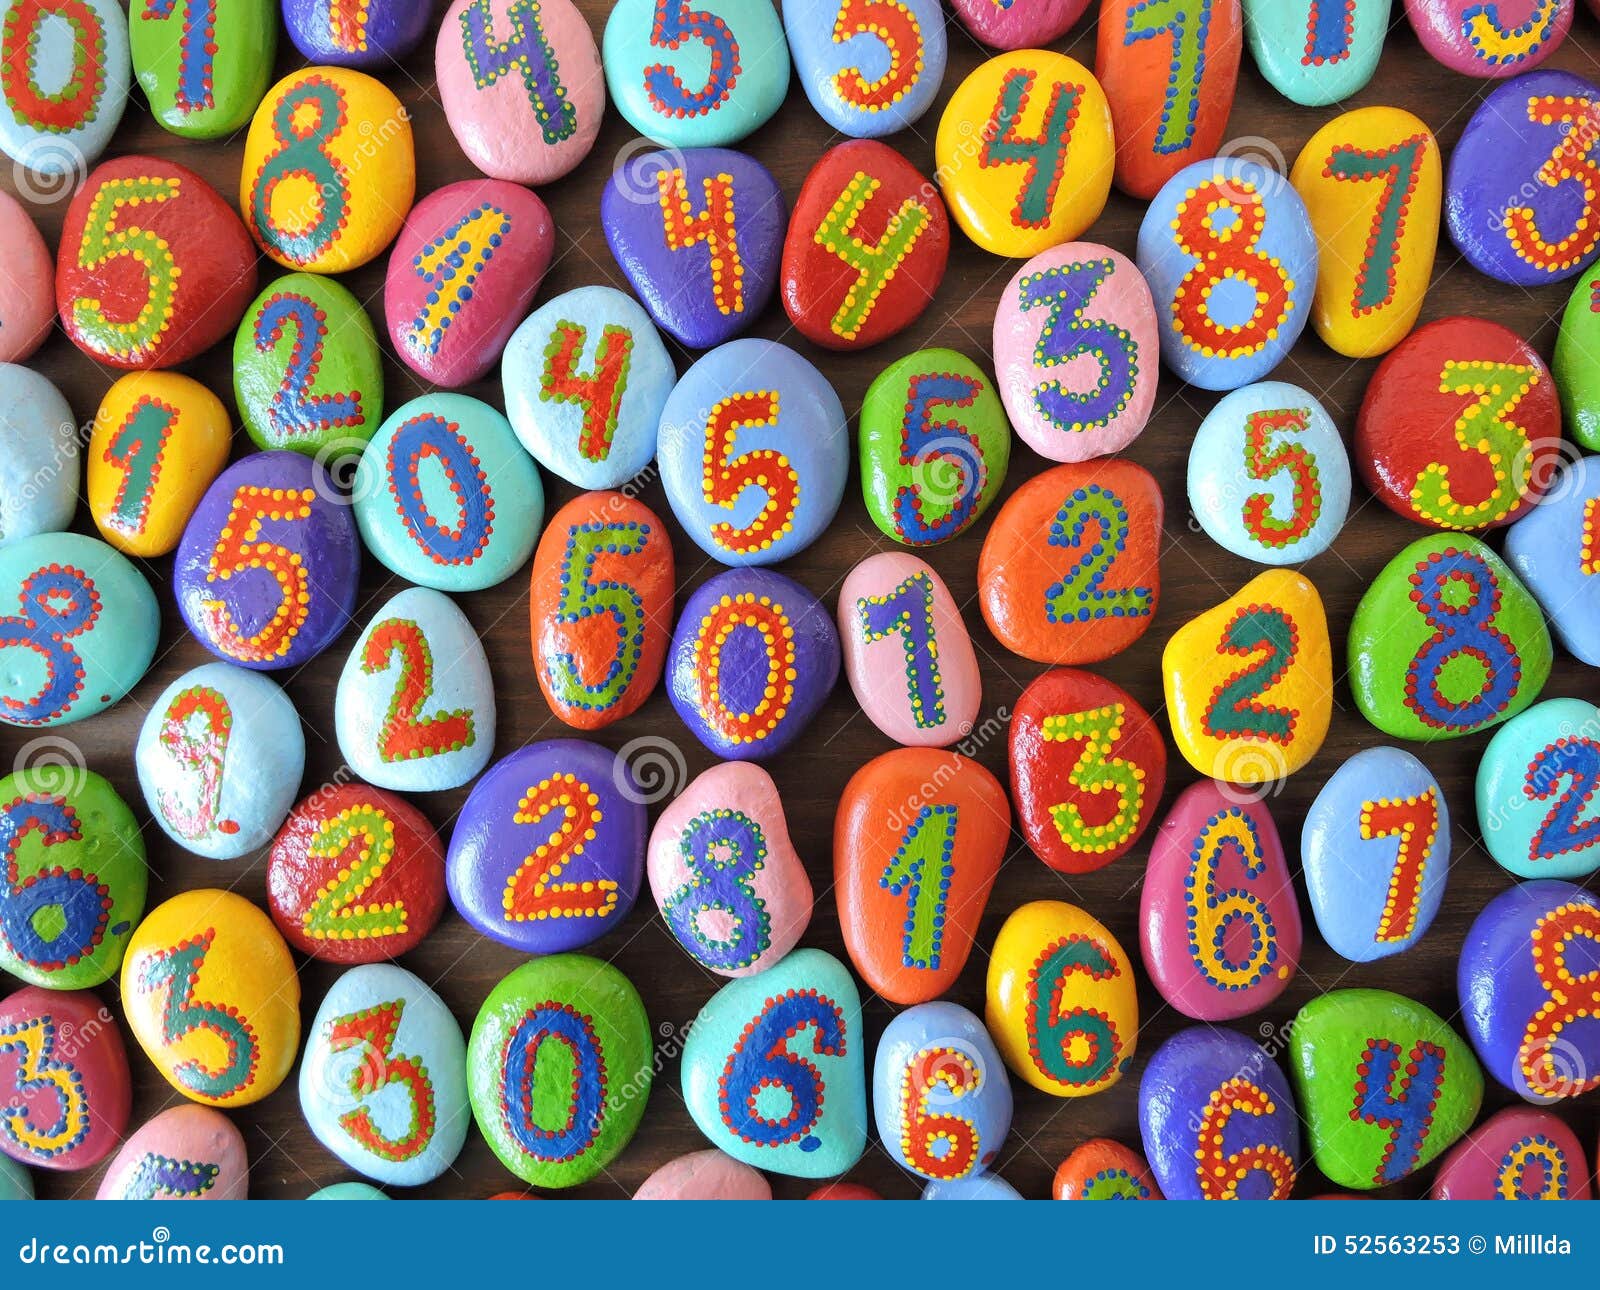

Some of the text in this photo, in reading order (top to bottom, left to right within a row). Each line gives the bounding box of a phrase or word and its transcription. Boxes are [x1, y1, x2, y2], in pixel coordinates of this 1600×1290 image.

[2, 0, 107, 133] 0
[459, 0, 577, 144] 4
[643, 0, 743, 118] 5
[249, 75, 349, 265] 8
[978, 68, 1086, 229] 4
[1322, 133, 1429, 318] 7
[1503, 96, 1600, 273] 3
[73, 176, 181, 358] 5
[410, 202, 512, 356] 1
[657, 167, 745, 315] 4
[813, 171, 932, 341] 4
[1170, 174, 1295, 359] 8
[253, 292, 365, 435] 2
[538, 319, 635, 464] 4
[1020, 258, 1138, 431] 3
[103, 394, 181, 535] 1
[387, 412, 495, 565] 0
[702, 390, 800, 555] 5
[892, 372, 990, 546] 5
[1243, 406, 1322, 549] 5
[1410, 359, 1540, 531] 3
[201, 485, 316, 662] 5
[547, 520, 651, 711] 5
[1044, 484, 1154, 624] 2
[360, 616, 476, 763] 2
[691, 592, 797, 744] 0
[1201, 602, 1300, 746] 2
[1403, 546, 1522, 732] 8
[159, 684, 234, 841] 9
[1040, 702, 1146, 853] 3
[1526, 735, 1600, 861] 2
[0, 791, 113, 972] 6
[303, 803, 409, 940] 2
[502, 772, 618, 922] 2
[663, 809, 771, 969] 8
[879, 803, 959, 971] 1
[1184, 805, 1278, 992] 6
[1359, 785, 1438, 943] 7
[0, 1015, 91, 1159] 3
[137, 926, 261, 1101] 3
[322, 997, 437, 1162] 3
[500, 1001, 608, 1164] 0
[718, 988, 848, 1148] 6
[1027, 933, 1122, 1088] 6
[899, 1046, 982, 1180] 6
[1195, 1078, 1297, 1200] 6
[1349, 1037, 1447, 1185] 4
